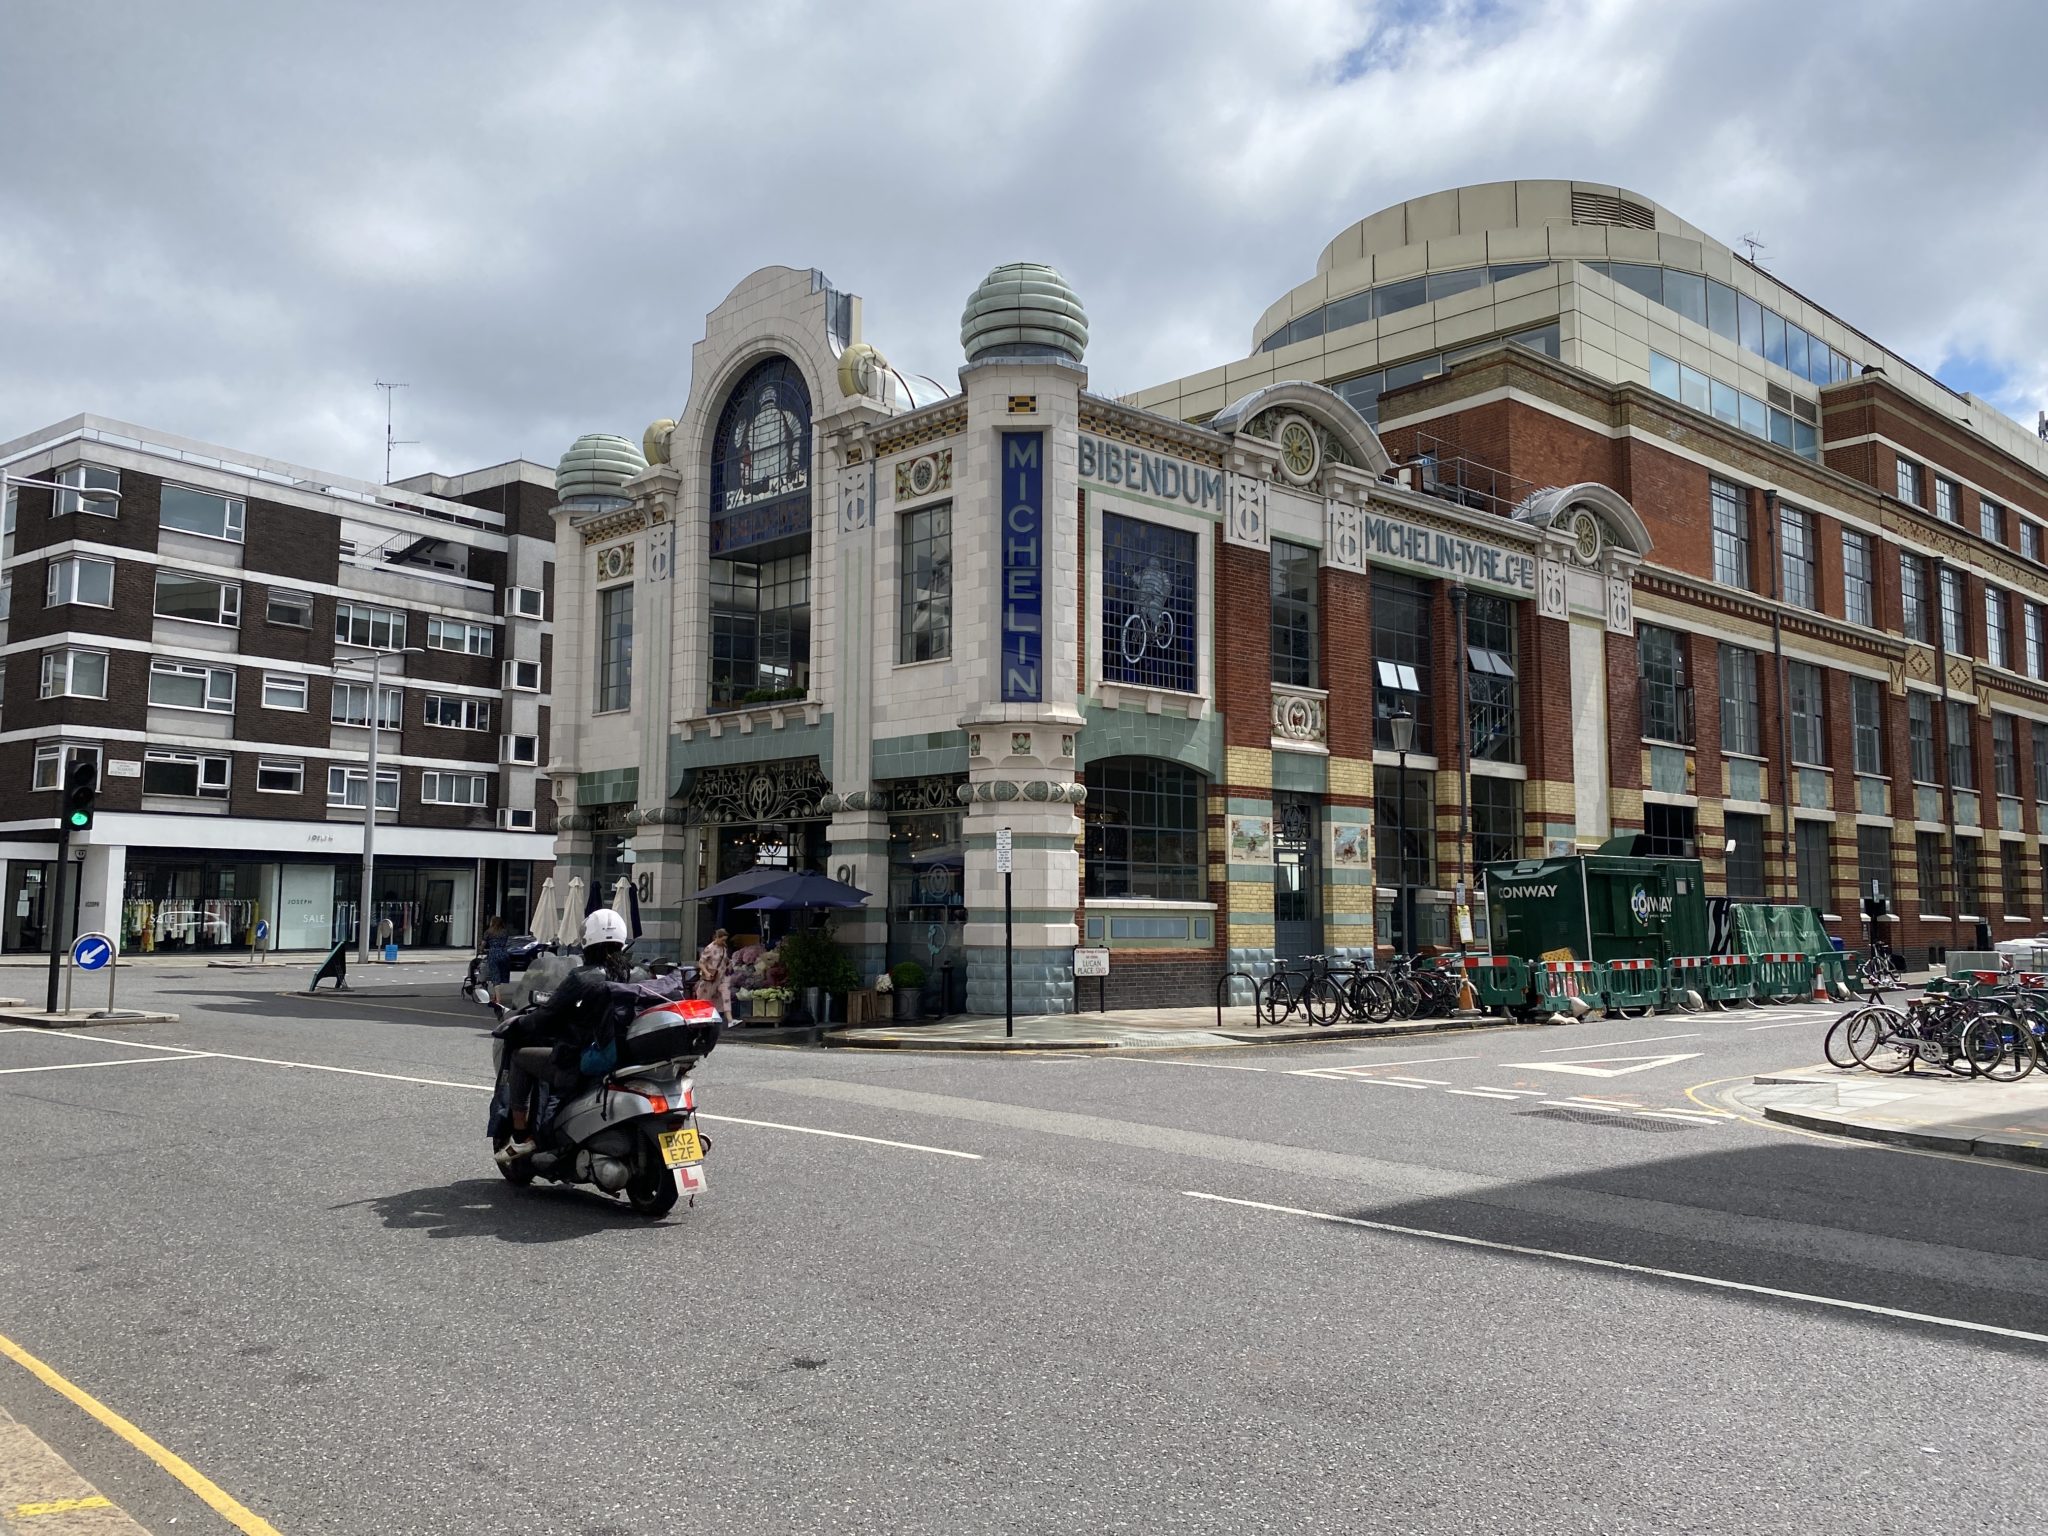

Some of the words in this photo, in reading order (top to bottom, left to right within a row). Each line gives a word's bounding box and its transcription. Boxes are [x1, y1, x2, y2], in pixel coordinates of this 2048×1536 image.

[1078, 435, 1222, 511] BIBENDUM
[1007, 439, 1038, 697] MICHELIN
[638, 871, 655, 903] 81
[303, 914, 325, 923] SALE
[433, 914, 454, 923] SALE
[669, 1146, 695, 1161] EZF
[681, 1168, 699, 1189] L
